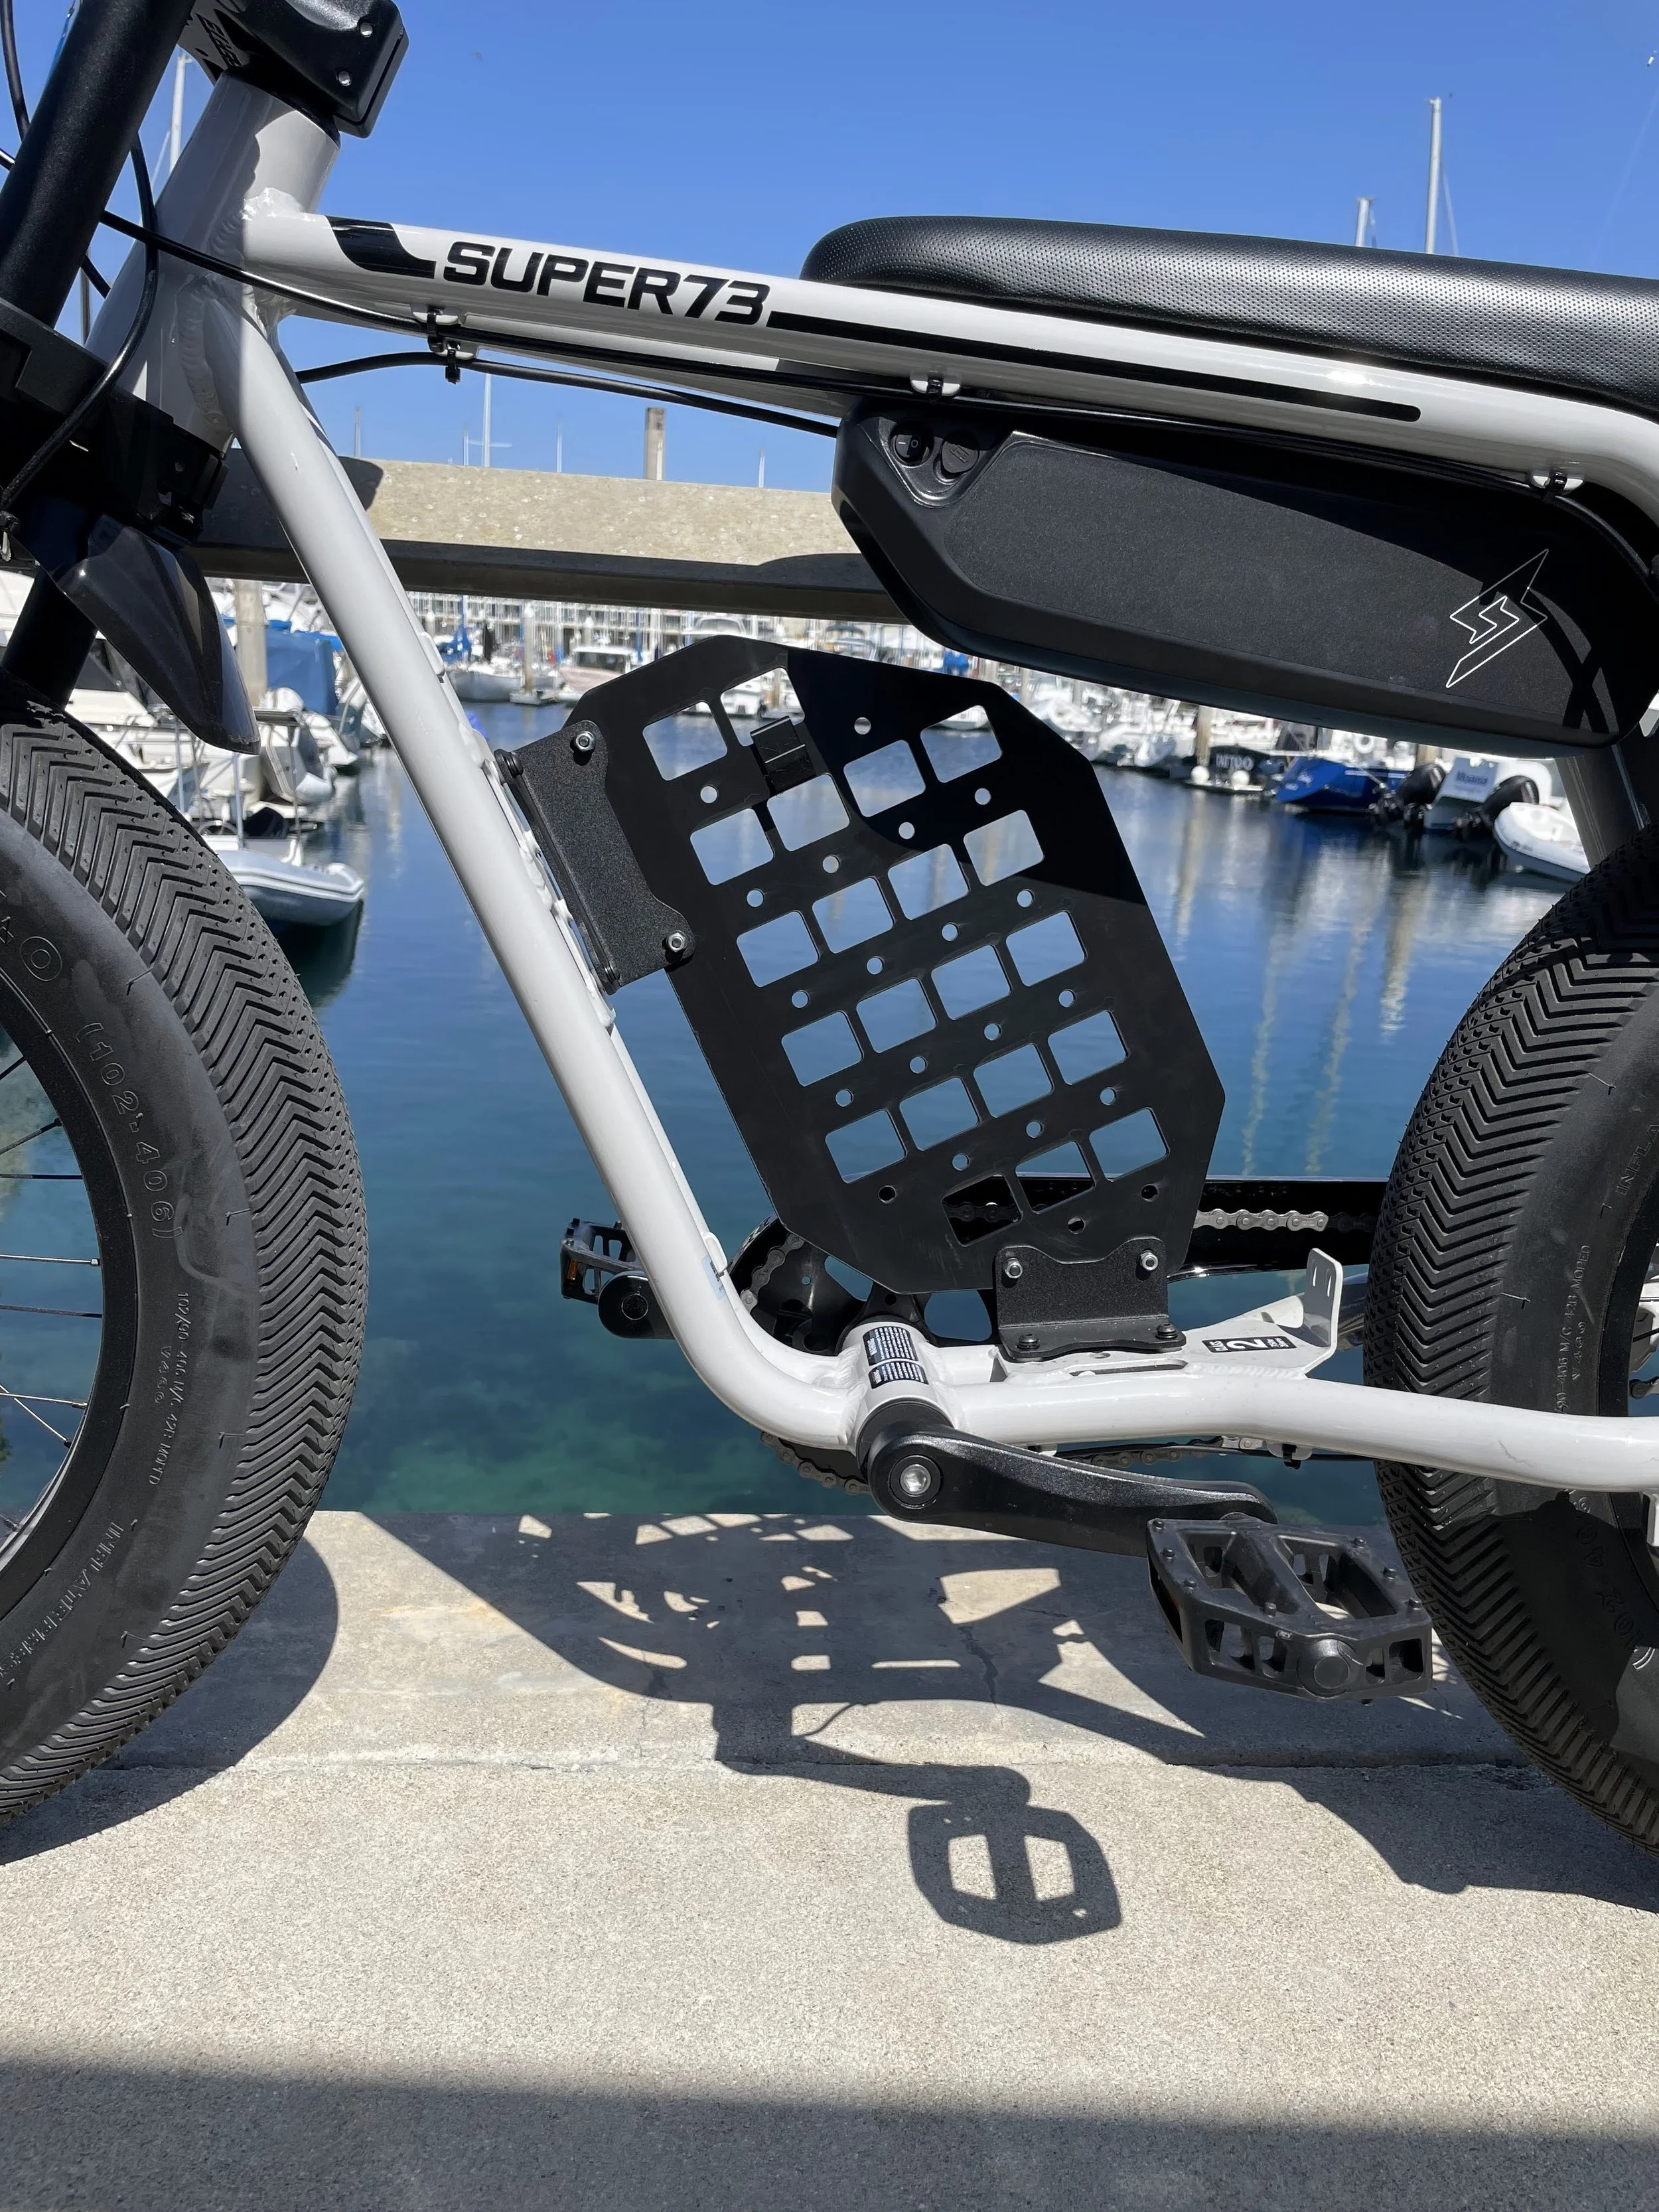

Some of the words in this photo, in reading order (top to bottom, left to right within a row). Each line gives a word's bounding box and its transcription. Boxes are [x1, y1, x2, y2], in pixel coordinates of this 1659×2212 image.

[443, 241, 770, 326] SUPER73
[1570, 1244, 1591, 1290] MOPED
[1226, 1338, 1269, 1350] 2
